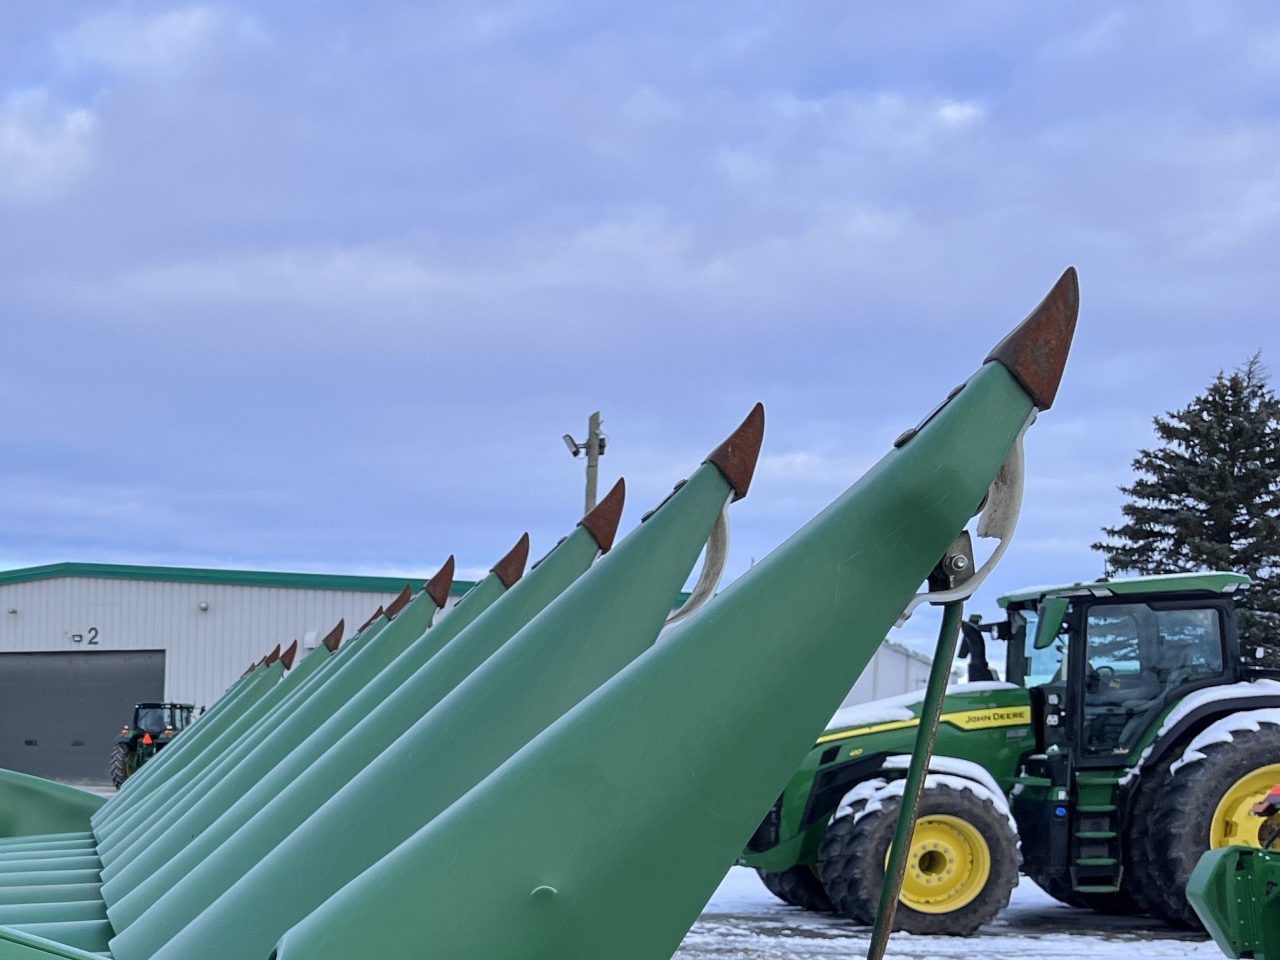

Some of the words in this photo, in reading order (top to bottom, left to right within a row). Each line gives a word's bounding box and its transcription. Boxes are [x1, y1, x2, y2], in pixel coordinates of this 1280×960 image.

[87, 626, 99, 645] 2
[965, 715, 991, 723] JOHN
[992, 711, 1025, 721] DEERE
